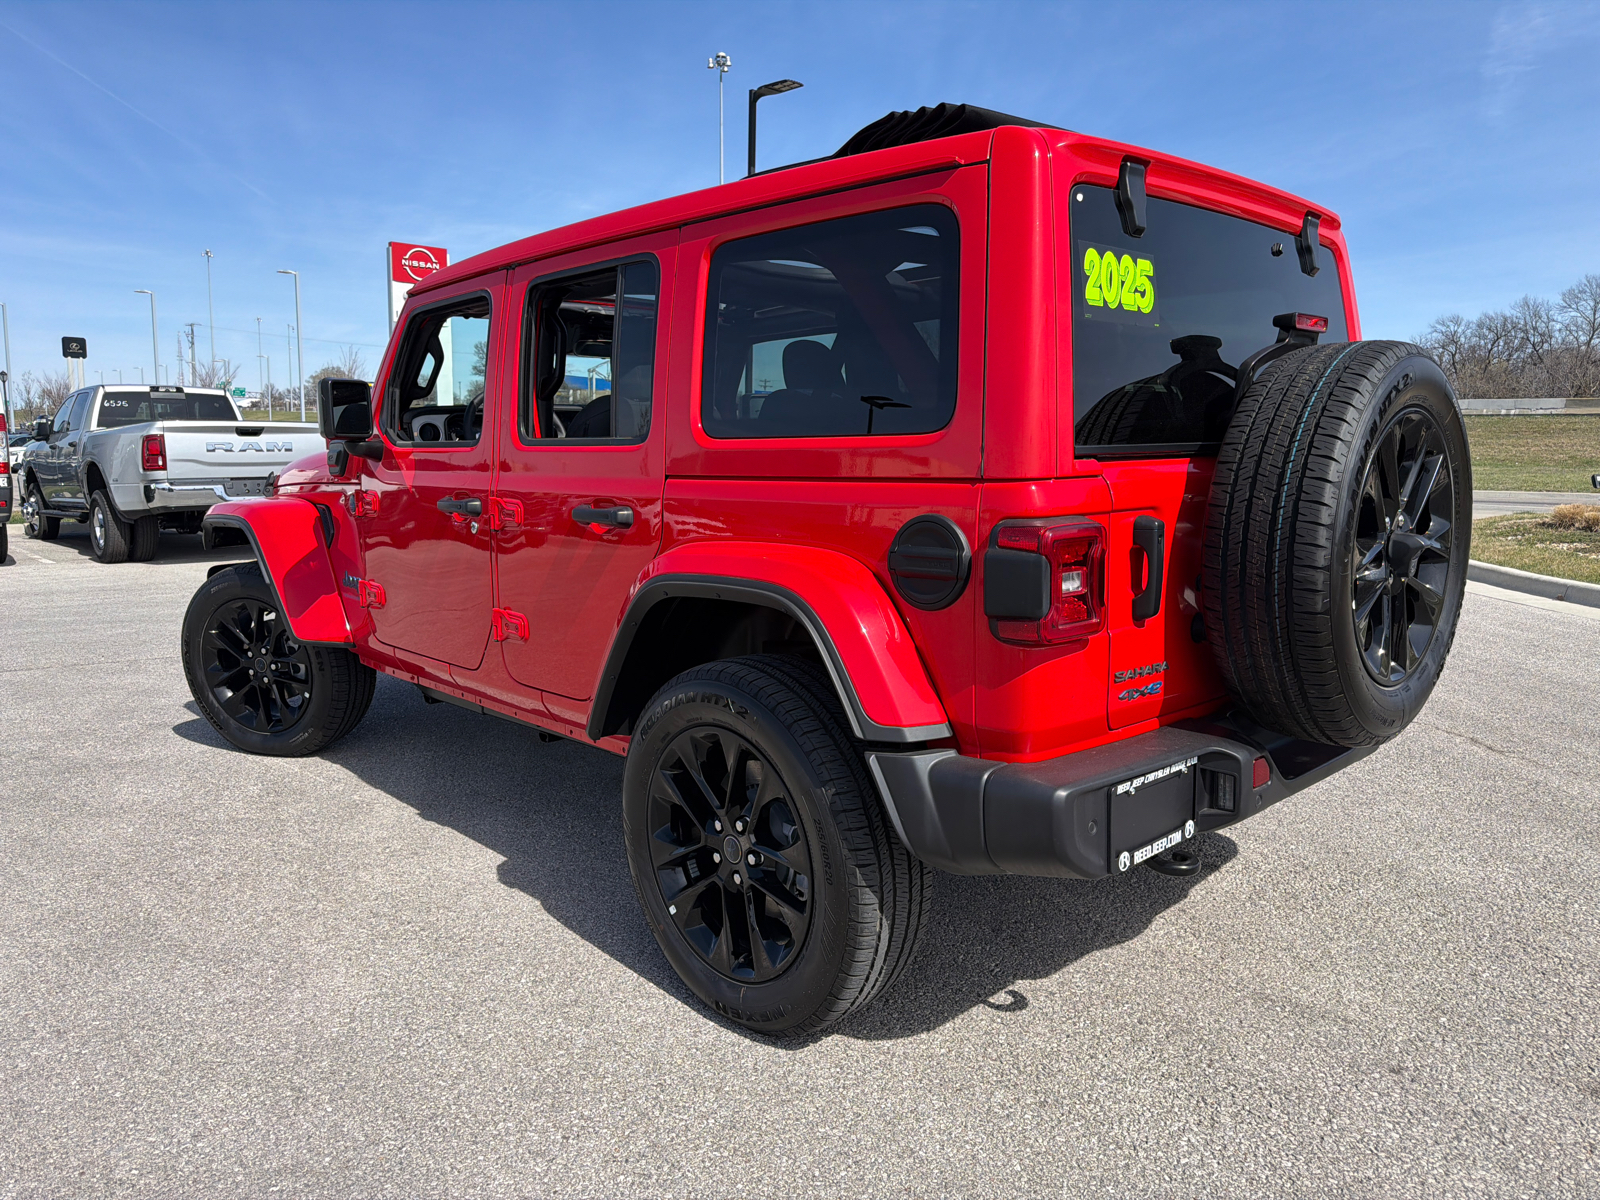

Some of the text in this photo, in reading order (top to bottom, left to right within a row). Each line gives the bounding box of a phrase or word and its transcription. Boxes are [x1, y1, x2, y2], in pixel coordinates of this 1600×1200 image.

[401, 259, 440, 270] NISSAN
[1084, 247, 1155, 314] 2025
[206, 441, 293, 452] RAM
[1114, 661, 1170, 684] SAHARA
[1144, 766, 1170, 783] CHRYSLER
[813, 818, 834, 886] 255/60R20
[1133, 829, 1183, 865] REEDJEEP.COM
